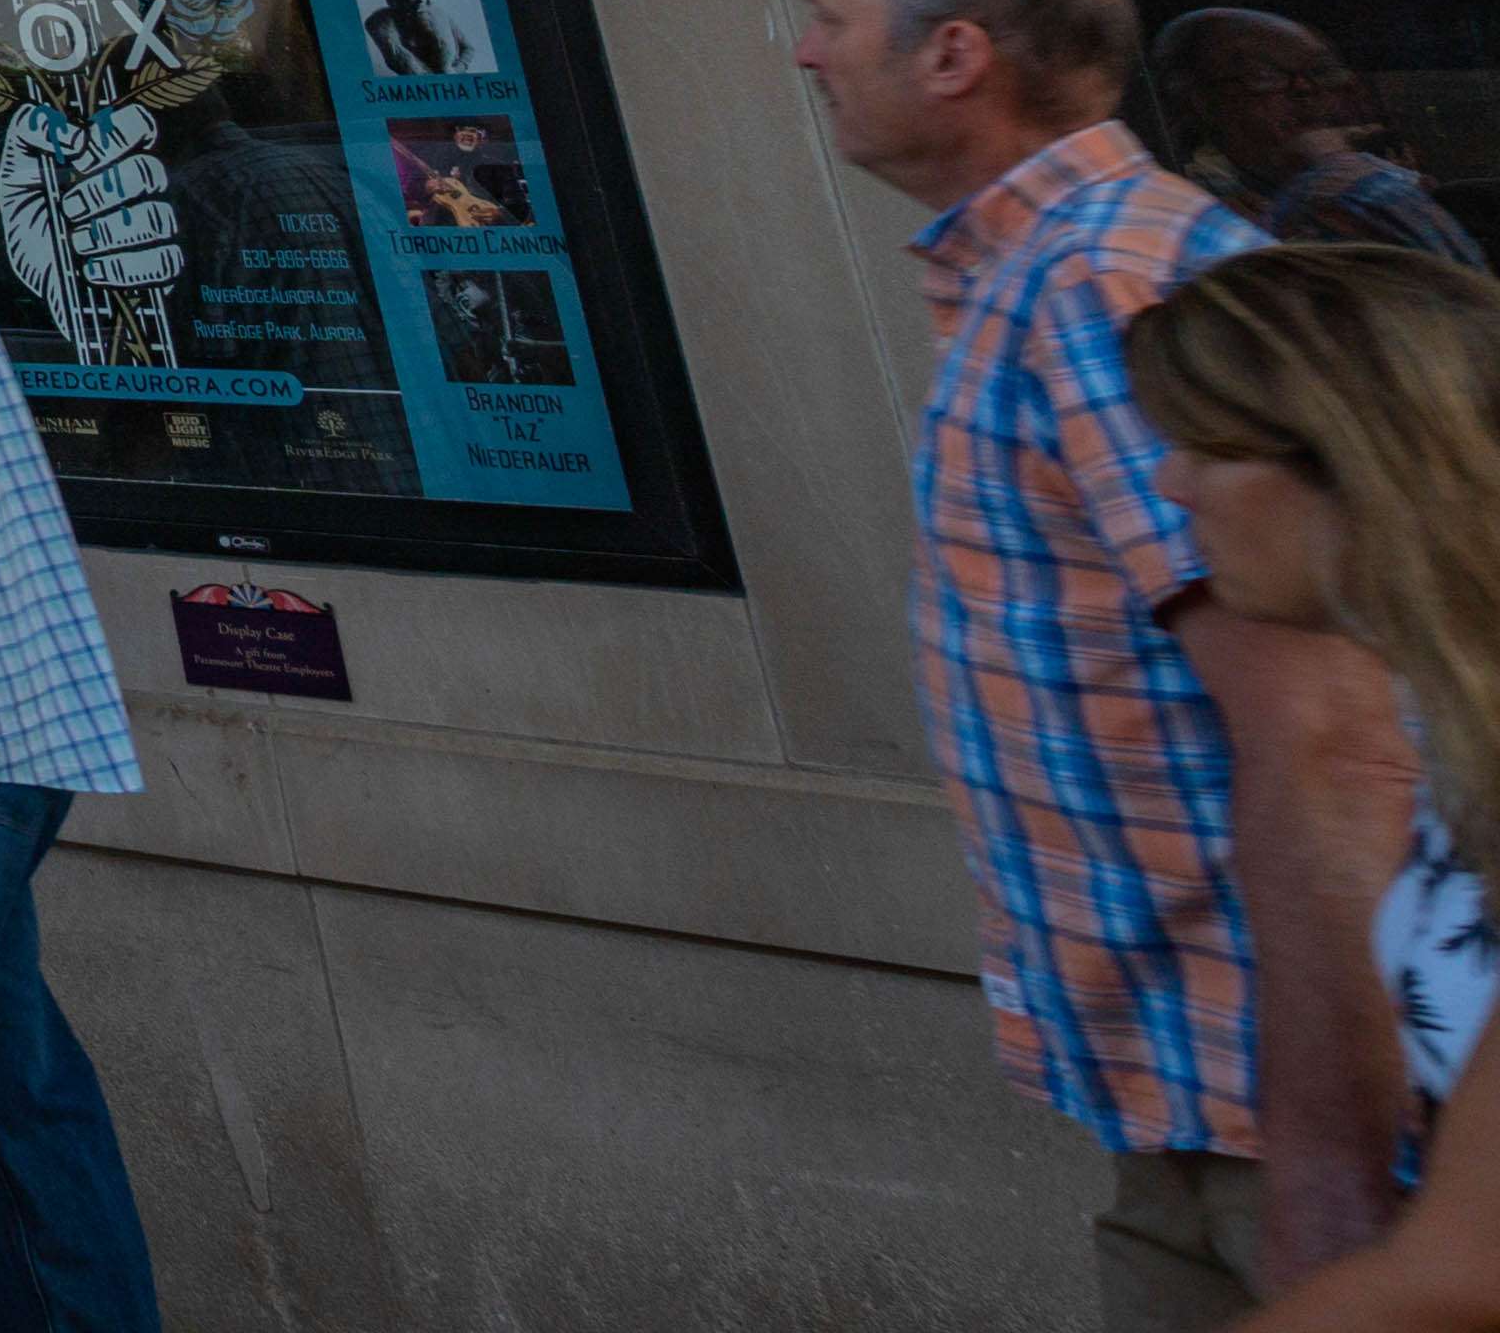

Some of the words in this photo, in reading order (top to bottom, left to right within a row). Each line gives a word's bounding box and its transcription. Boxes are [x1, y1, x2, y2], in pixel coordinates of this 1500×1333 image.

[276, 213, 342, 233] TICKETS:
[240, 249, 349, 269] 630-896-6666
[34, 411, 98, 431] UNHAM
[171, 415, 201, 427] BUD
[168, 424, 210, 437] LIGHT
[171, 437, 210, 449] MUSIC
[218, 622, 262, 642] Display
[265, 627, 295, 641] Case
[263, 650, 286, 660] from
